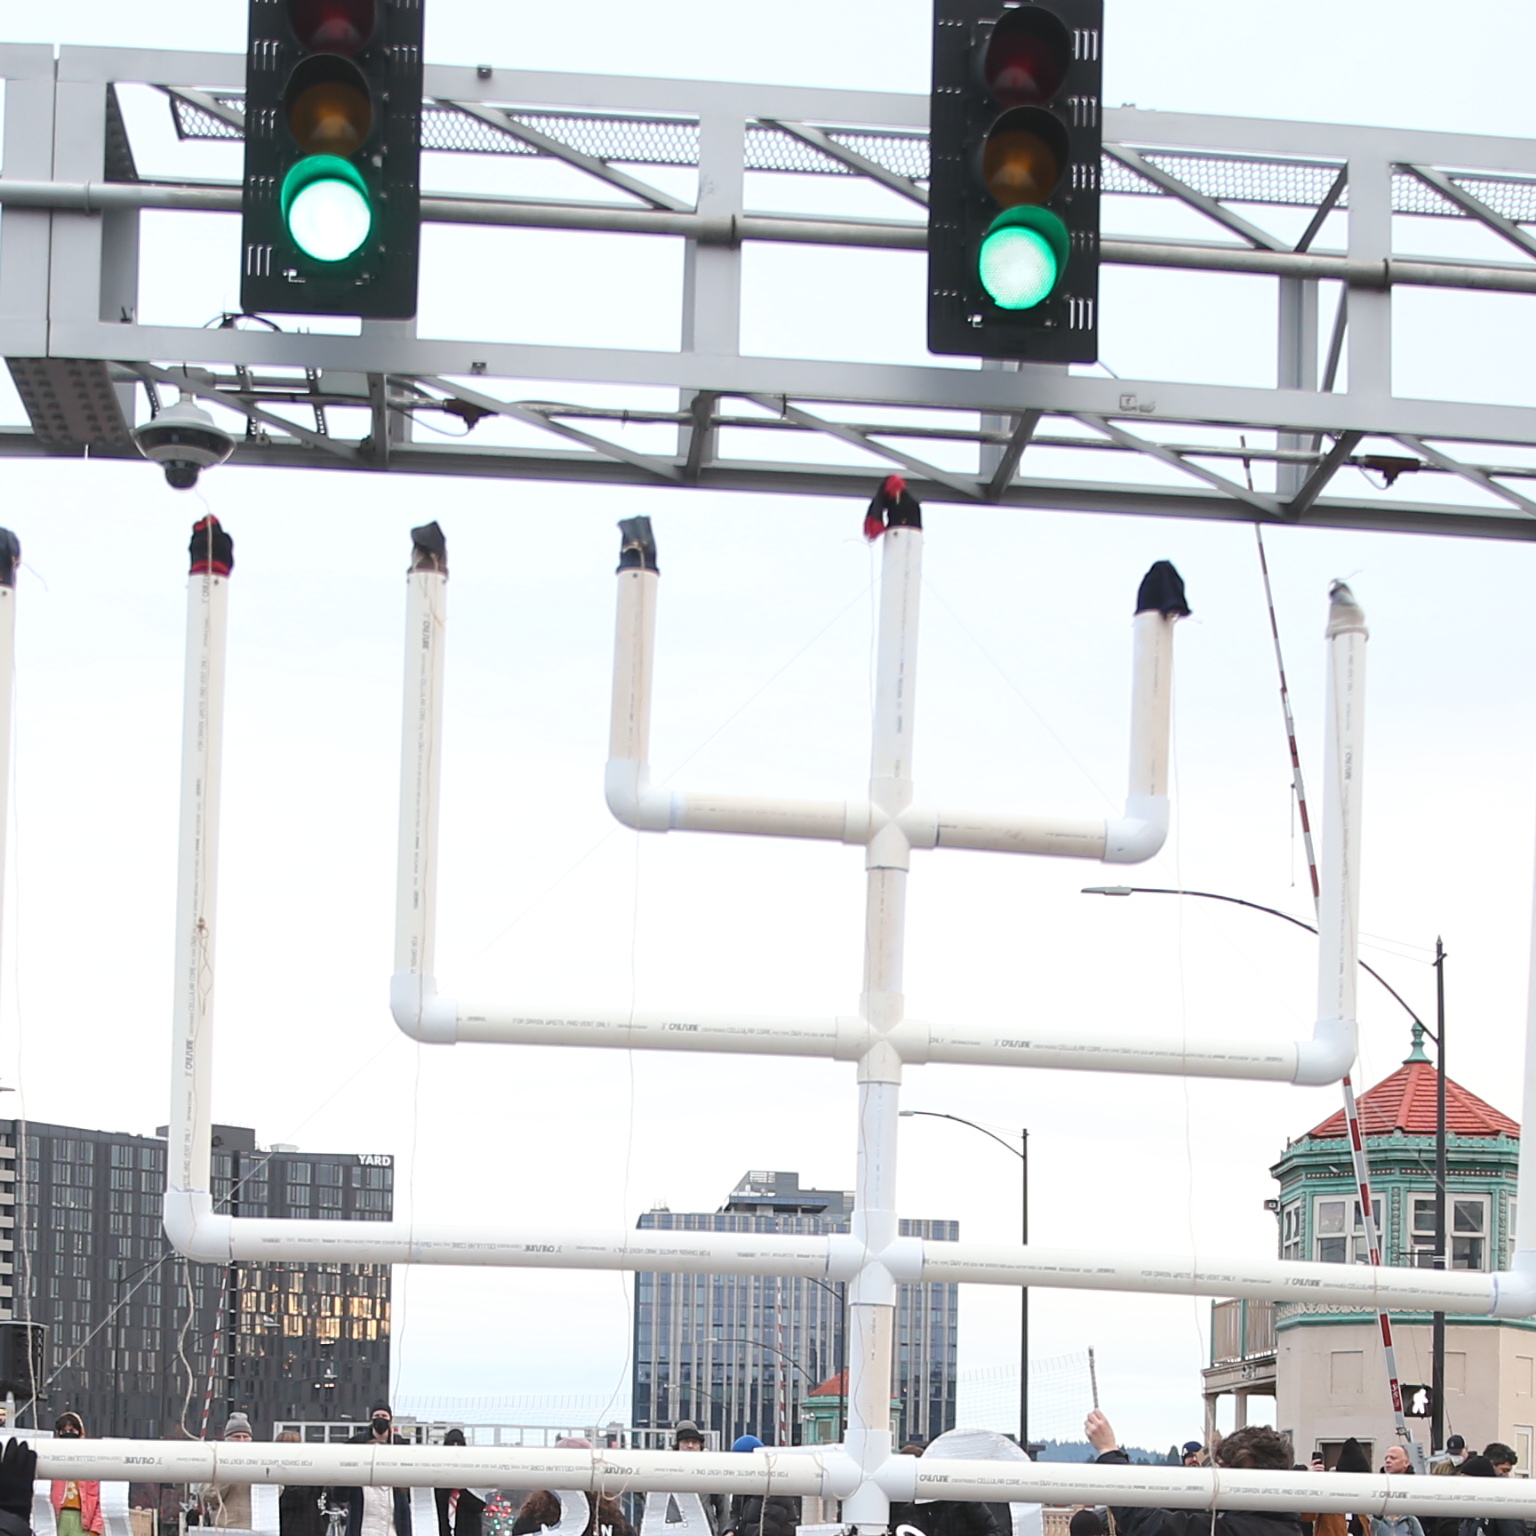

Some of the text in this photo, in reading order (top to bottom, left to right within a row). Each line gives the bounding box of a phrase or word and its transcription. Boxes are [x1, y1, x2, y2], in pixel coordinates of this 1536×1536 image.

[358, 1155, 391, 1166] YARD
[229, 1457, 245, 1465] VENT
[260, 1458, 279, 1466] WASTE
[690, 1468, 706, 1476] ONLY
[706, 1468, 721, 1476] VENT
[735, 1469, 756, 1477] WASTE
[976, 1477, 1005, 1485] CELLULAR
[1005, 1478, 1020, 1486] CORE
[1241, 1486, 1259, 1494] DRAIN
[1261, 1487, 1280, 1495] WASTE
[1294, 1488, 1308, 1496] VENT
